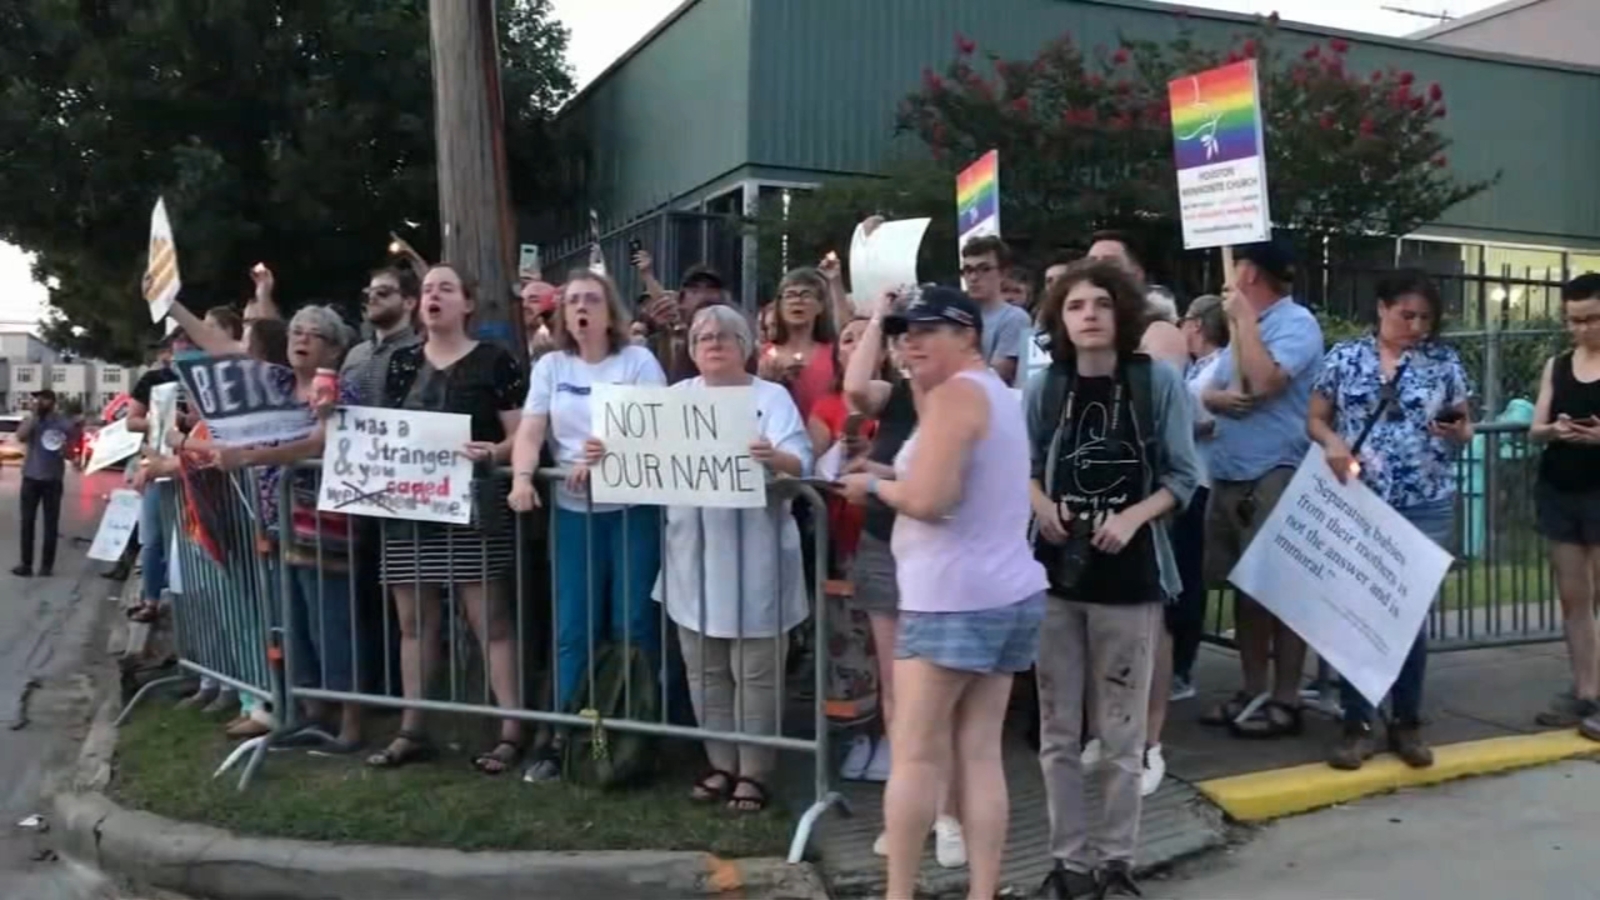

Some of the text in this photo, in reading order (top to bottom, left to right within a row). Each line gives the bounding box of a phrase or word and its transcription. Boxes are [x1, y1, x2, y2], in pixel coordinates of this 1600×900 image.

[355, 417, 388, 436] was
[398, 420, 409, 437] a
[605, 401, 717, 440] NOT IN
[334, 437, 457, 477] & Stranger
[602, 452, 755, 492] OUR NAME
[357, 462, 451, 505] you caged
[1296, 493, 1409, 598] from their mothers is
[1284, 513, 1401, 620] not the answer and is
